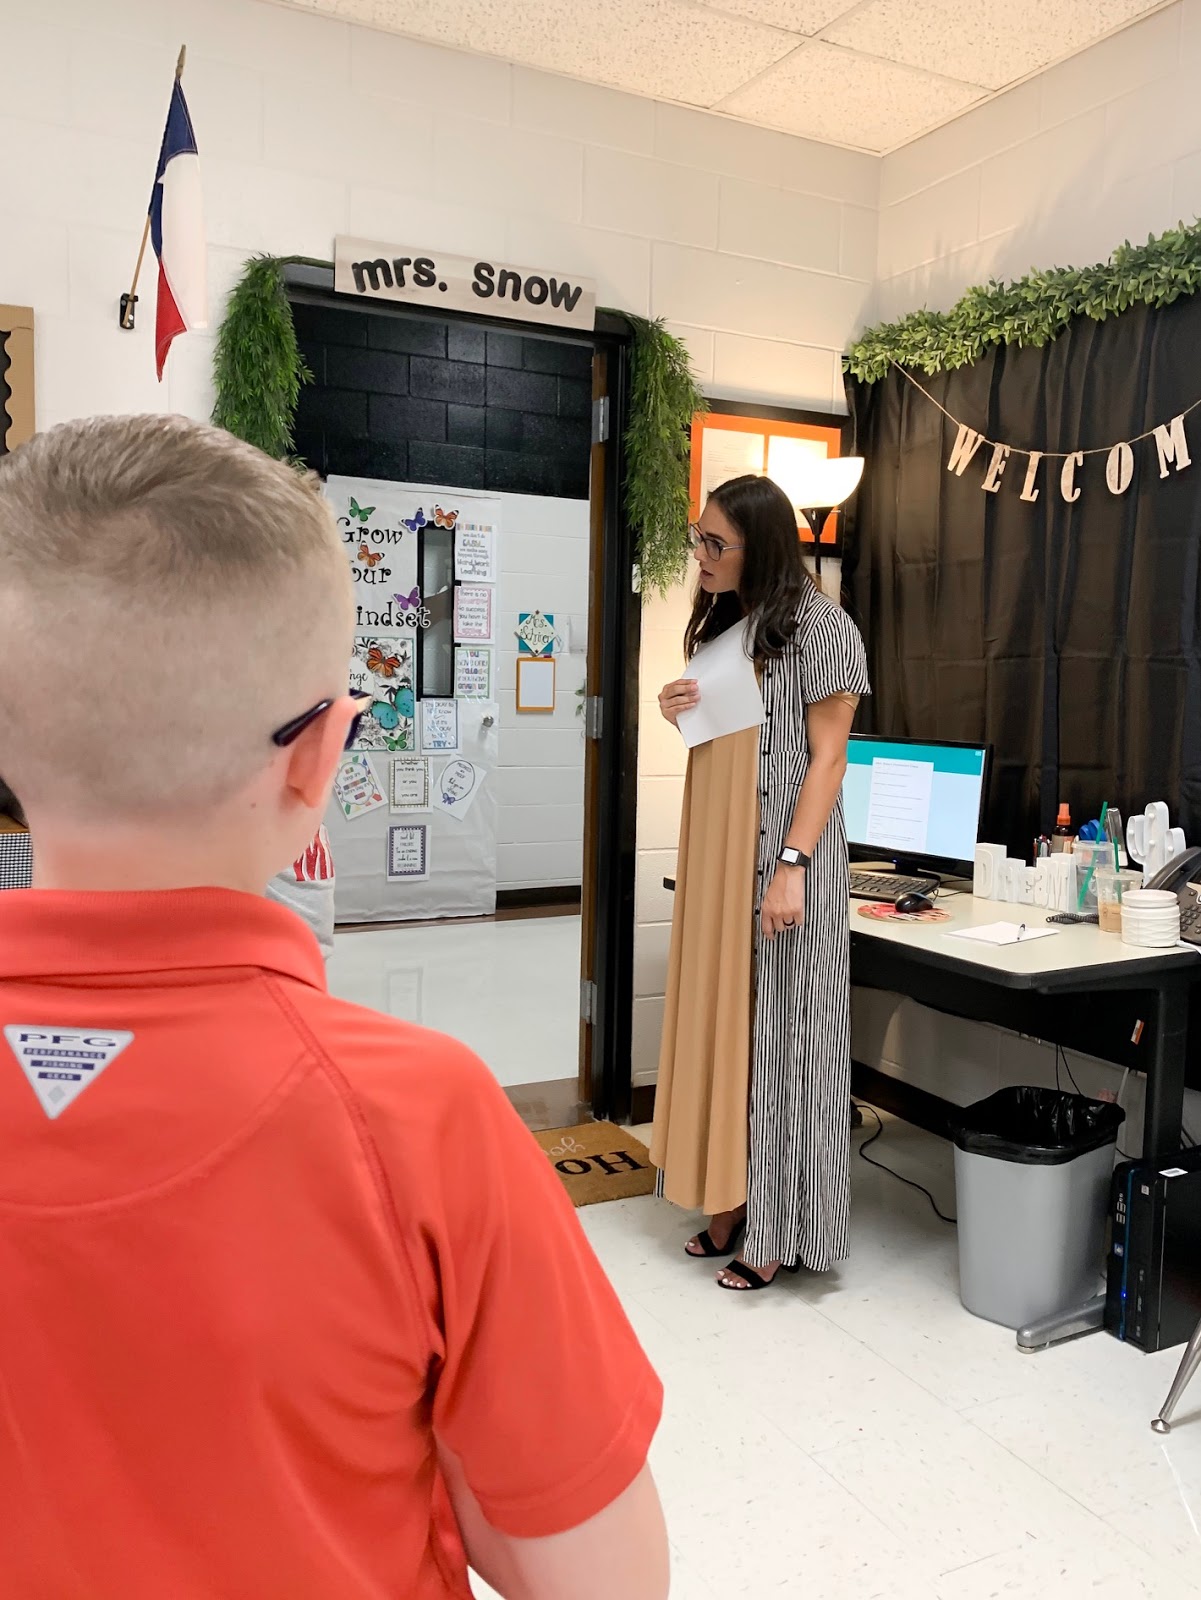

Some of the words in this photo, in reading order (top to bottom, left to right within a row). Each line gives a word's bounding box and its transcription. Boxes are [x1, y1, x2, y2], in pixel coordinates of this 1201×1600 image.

[351, 257, 448, 293] mrs.
[472, 262, 583, 313] snow
[350, 562, 391, 584] our
[356, 601, 431, 627] indset
[349, 673, 368, 686] nge
[19, 1033, 116, 1047] PFG
[555, 1150, 648, 1175] HO
